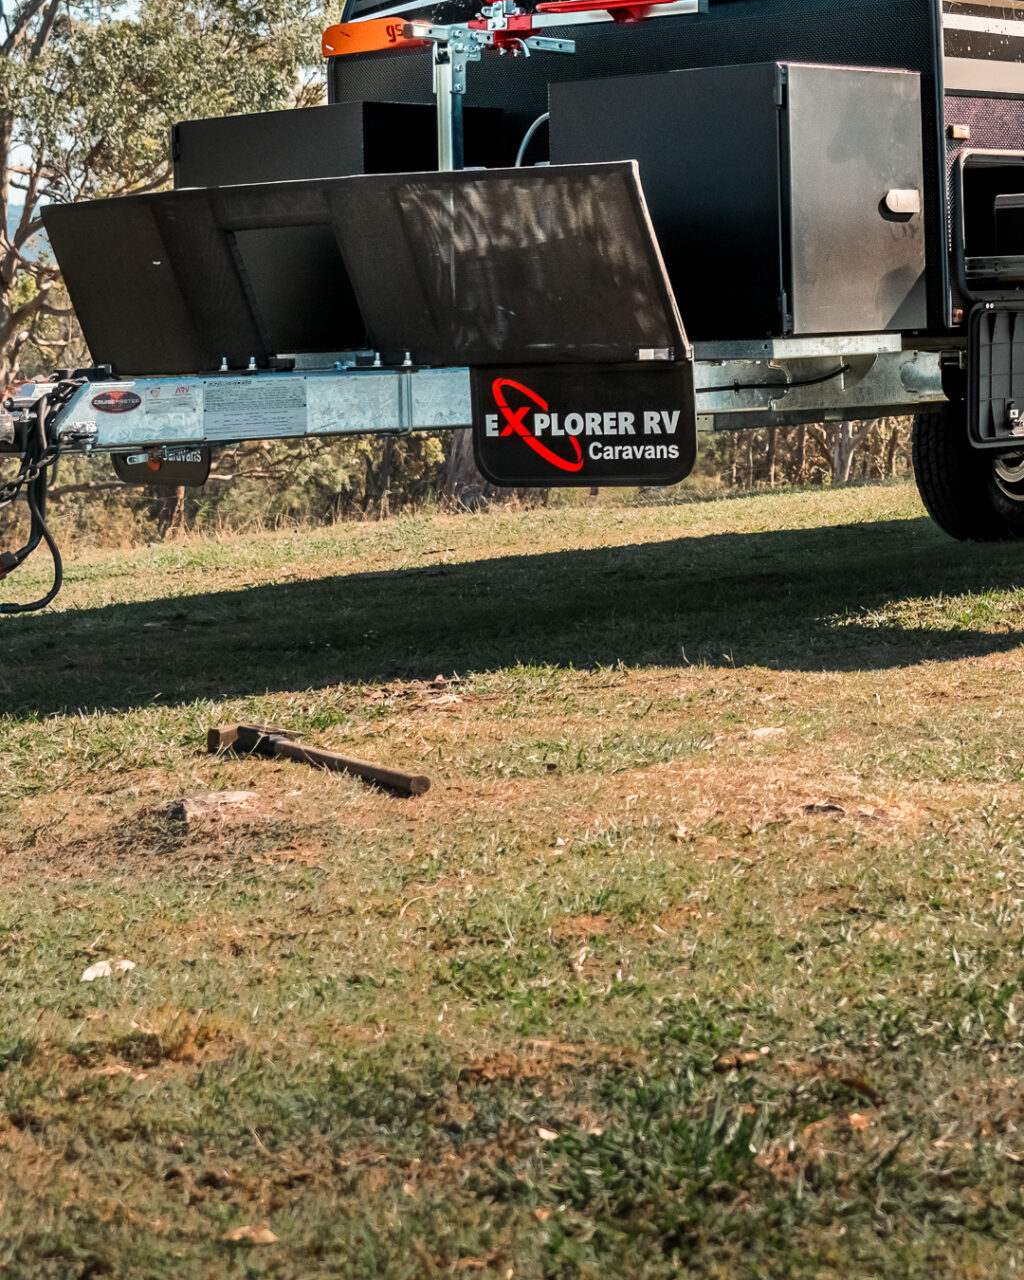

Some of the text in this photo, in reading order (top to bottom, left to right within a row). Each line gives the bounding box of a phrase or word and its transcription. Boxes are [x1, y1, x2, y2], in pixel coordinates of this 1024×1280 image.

[485, 407, 681, 437] EXPLORER RV
[588, 442, 680, 460] Caravans
